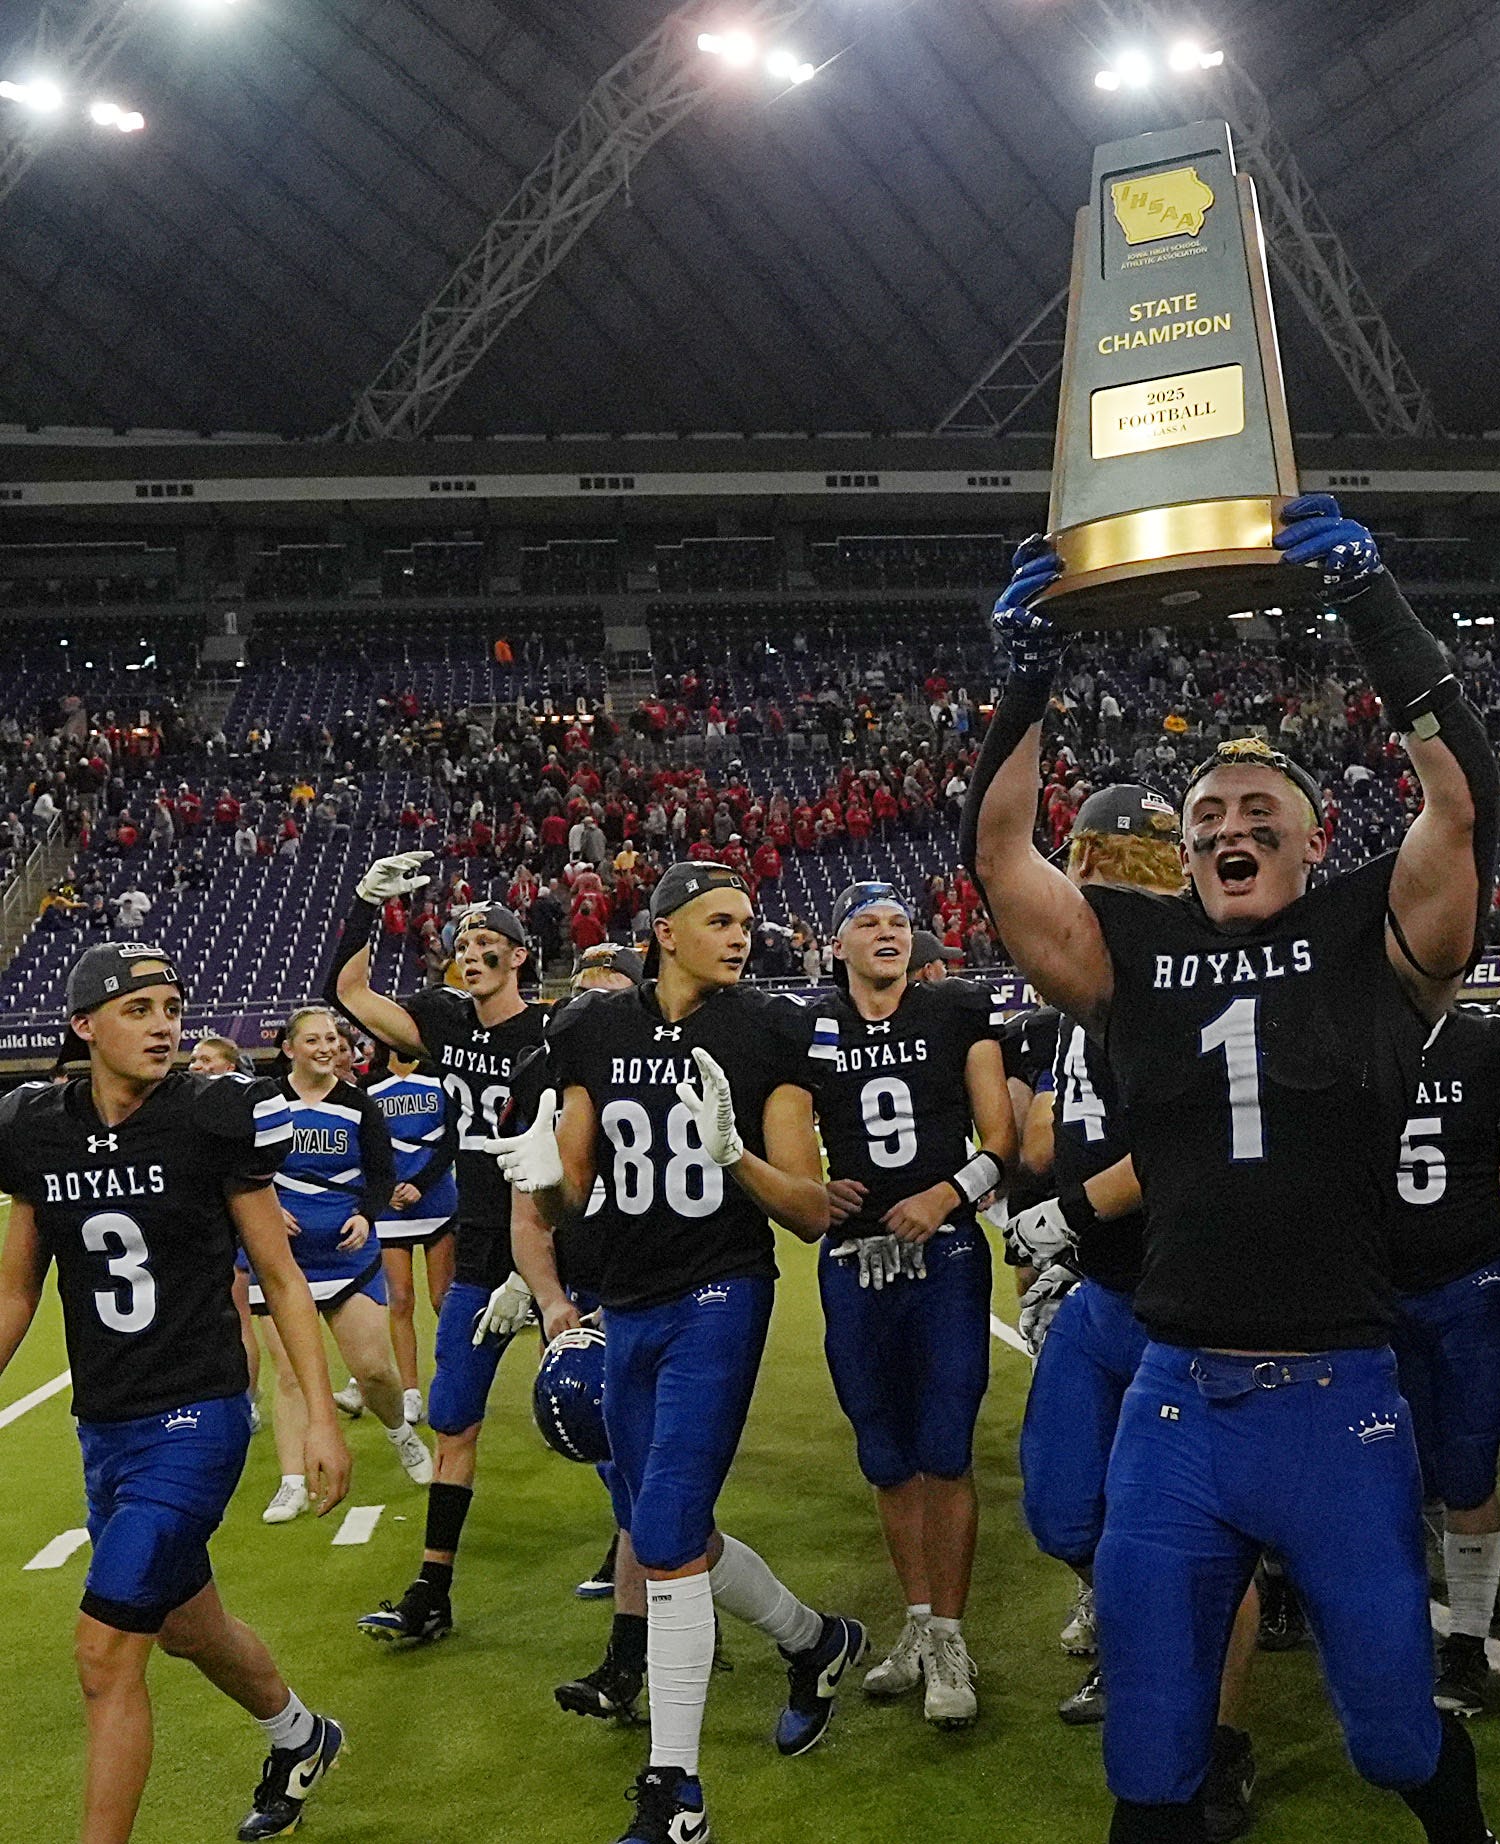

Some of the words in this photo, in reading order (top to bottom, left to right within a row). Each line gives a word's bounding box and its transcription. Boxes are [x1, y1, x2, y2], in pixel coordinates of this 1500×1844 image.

[1120, 185, 1195, 229] IHSAA
[1121, 255, 1155, 271] ATHLETIC
[1157, 247, 1208, 263] ASSOCIATION
[1128, 292, 1198, 323] STATE
[1098, 312, 1231, 355] CHAMPION
[1146, 387, 1185, 406] 2025
[1118, 401, 1217, 431] FOOTBALL
[1153, 939, 1313, 989] ROYALS
[31, 1032, 57, 1048] the
[180, 1024, 220, 1041] eeds.
[442, 1044, 511, 1078] ROYALS
[611, 1057, 697, 1084] ROYAL
[836, 1039, 928, 1073] ROYALS
[1201, 998, 1265, 1160] 1
[859, 1076, 918, 1168] 9
[291, 1128, 349, 1156] YALS
[601, 1099, 724, 1217] 88
[45, 1164, 166, 1202] ROYALS
[81, 1212, 158, 1334] 3
